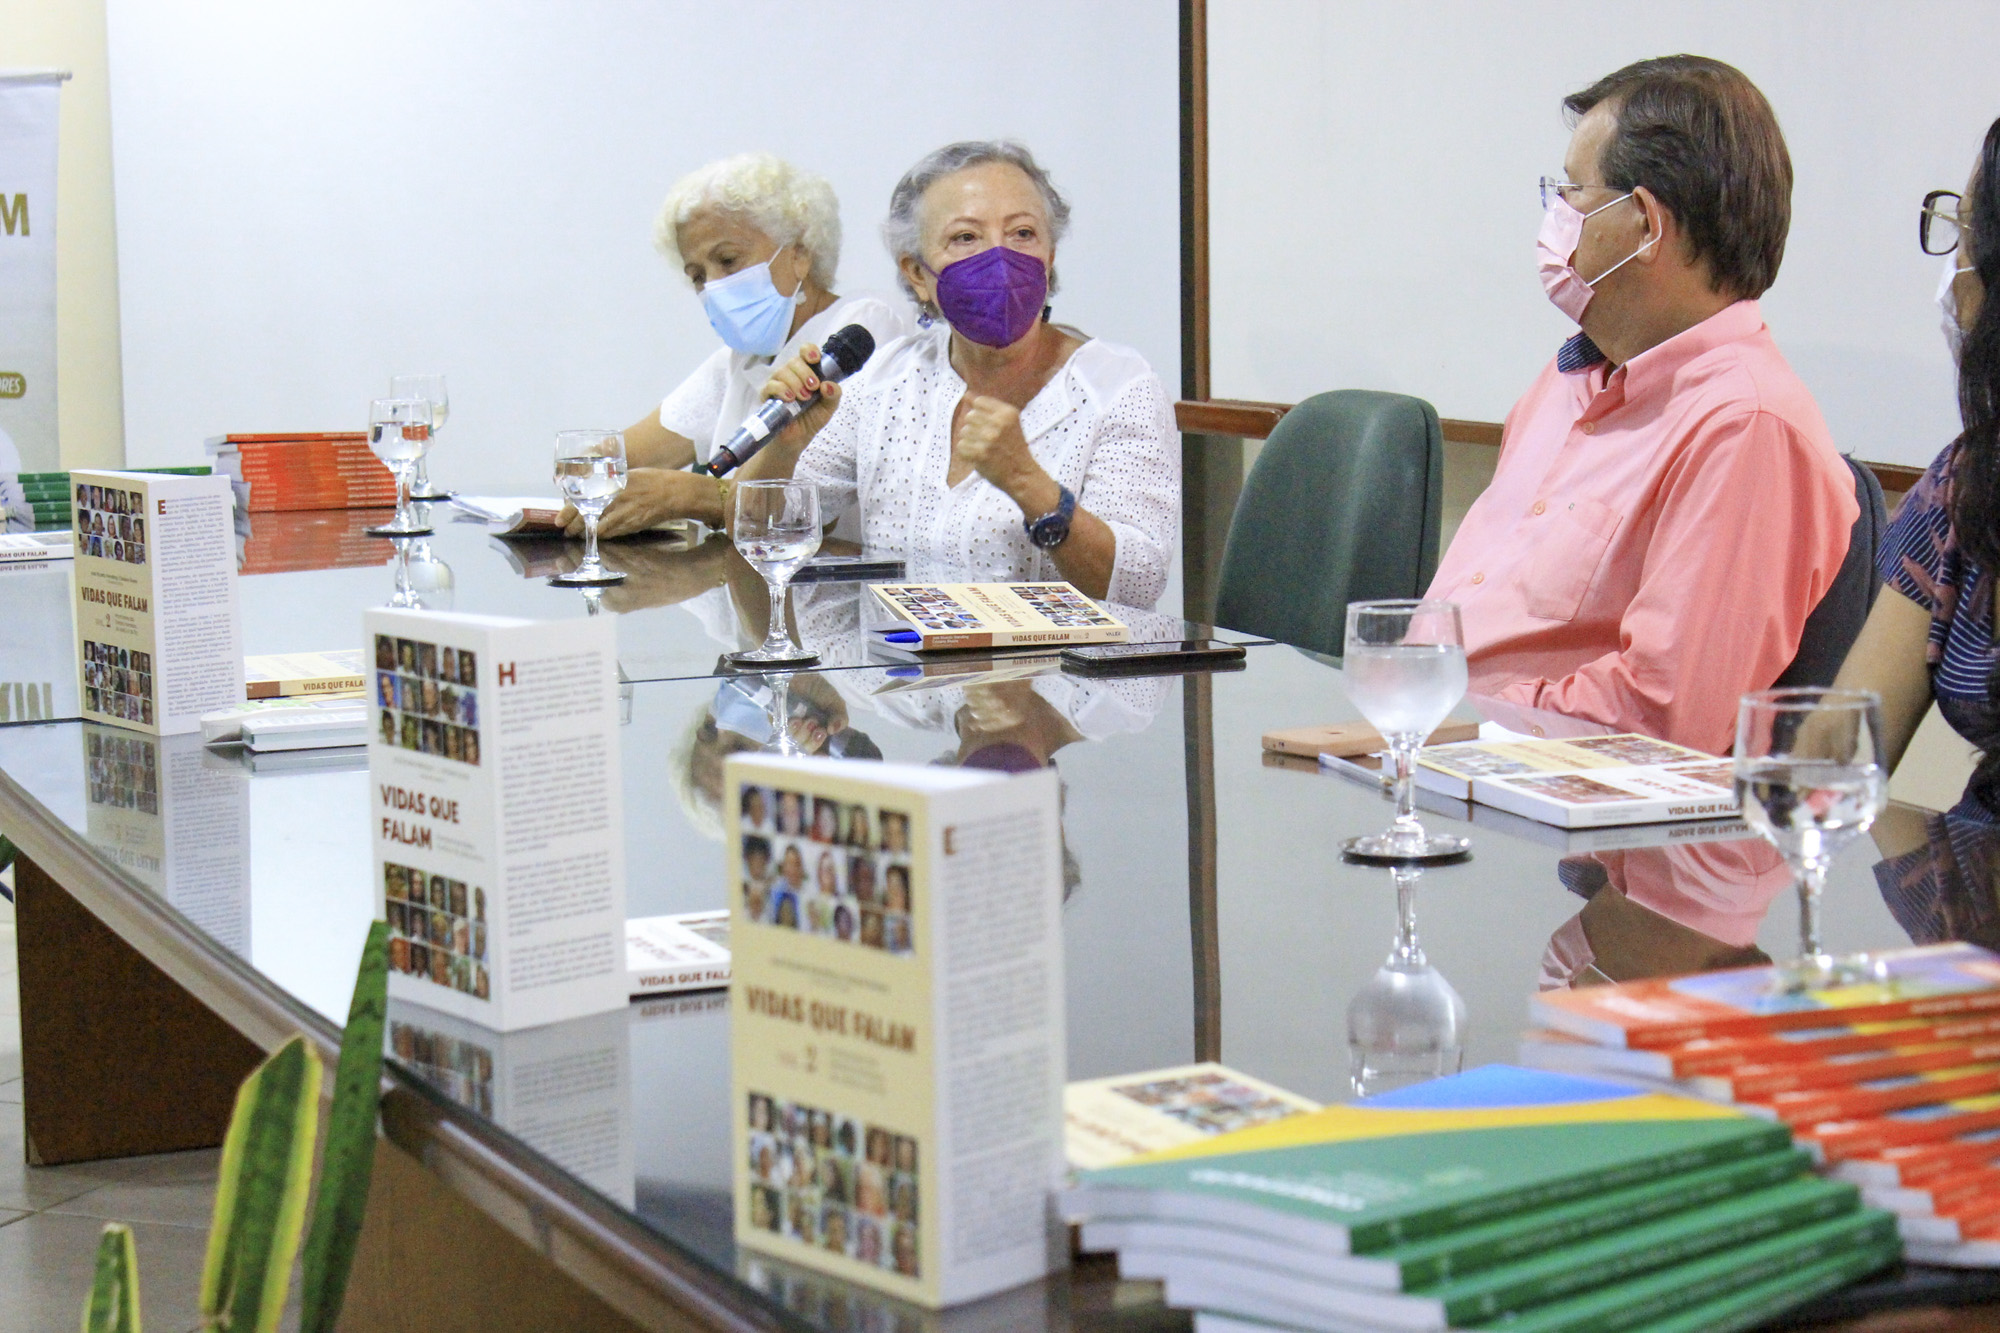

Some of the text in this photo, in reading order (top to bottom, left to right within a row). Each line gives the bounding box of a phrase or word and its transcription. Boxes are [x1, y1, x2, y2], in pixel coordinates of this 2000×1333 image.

[0, 377, 20, 393] RES
[158, 499, 167, 515] E
[81, 586, 148, 613] VIDAS QUE FALAM
[1011, 634, 1032, 642] VIDAS
[1033, 633, 1047, 641] QUE
[1047, 633, 1070, 641] FALAM
[498, 661, 516, 687] H
[303, 679, 367, 691] VIDAS QUE FALA
[380, 783, 460, 824] VIDAS QUE
[1668, 802, 1744, 815] VIDAS QUE FALA
[382, 817, 433, 851] FALAM
[639, 973, 675, 987] VIDAS
[678, 972, 703, 983] QUE
[746, 985, 917, 1054] VIDAS QUE FALAM
